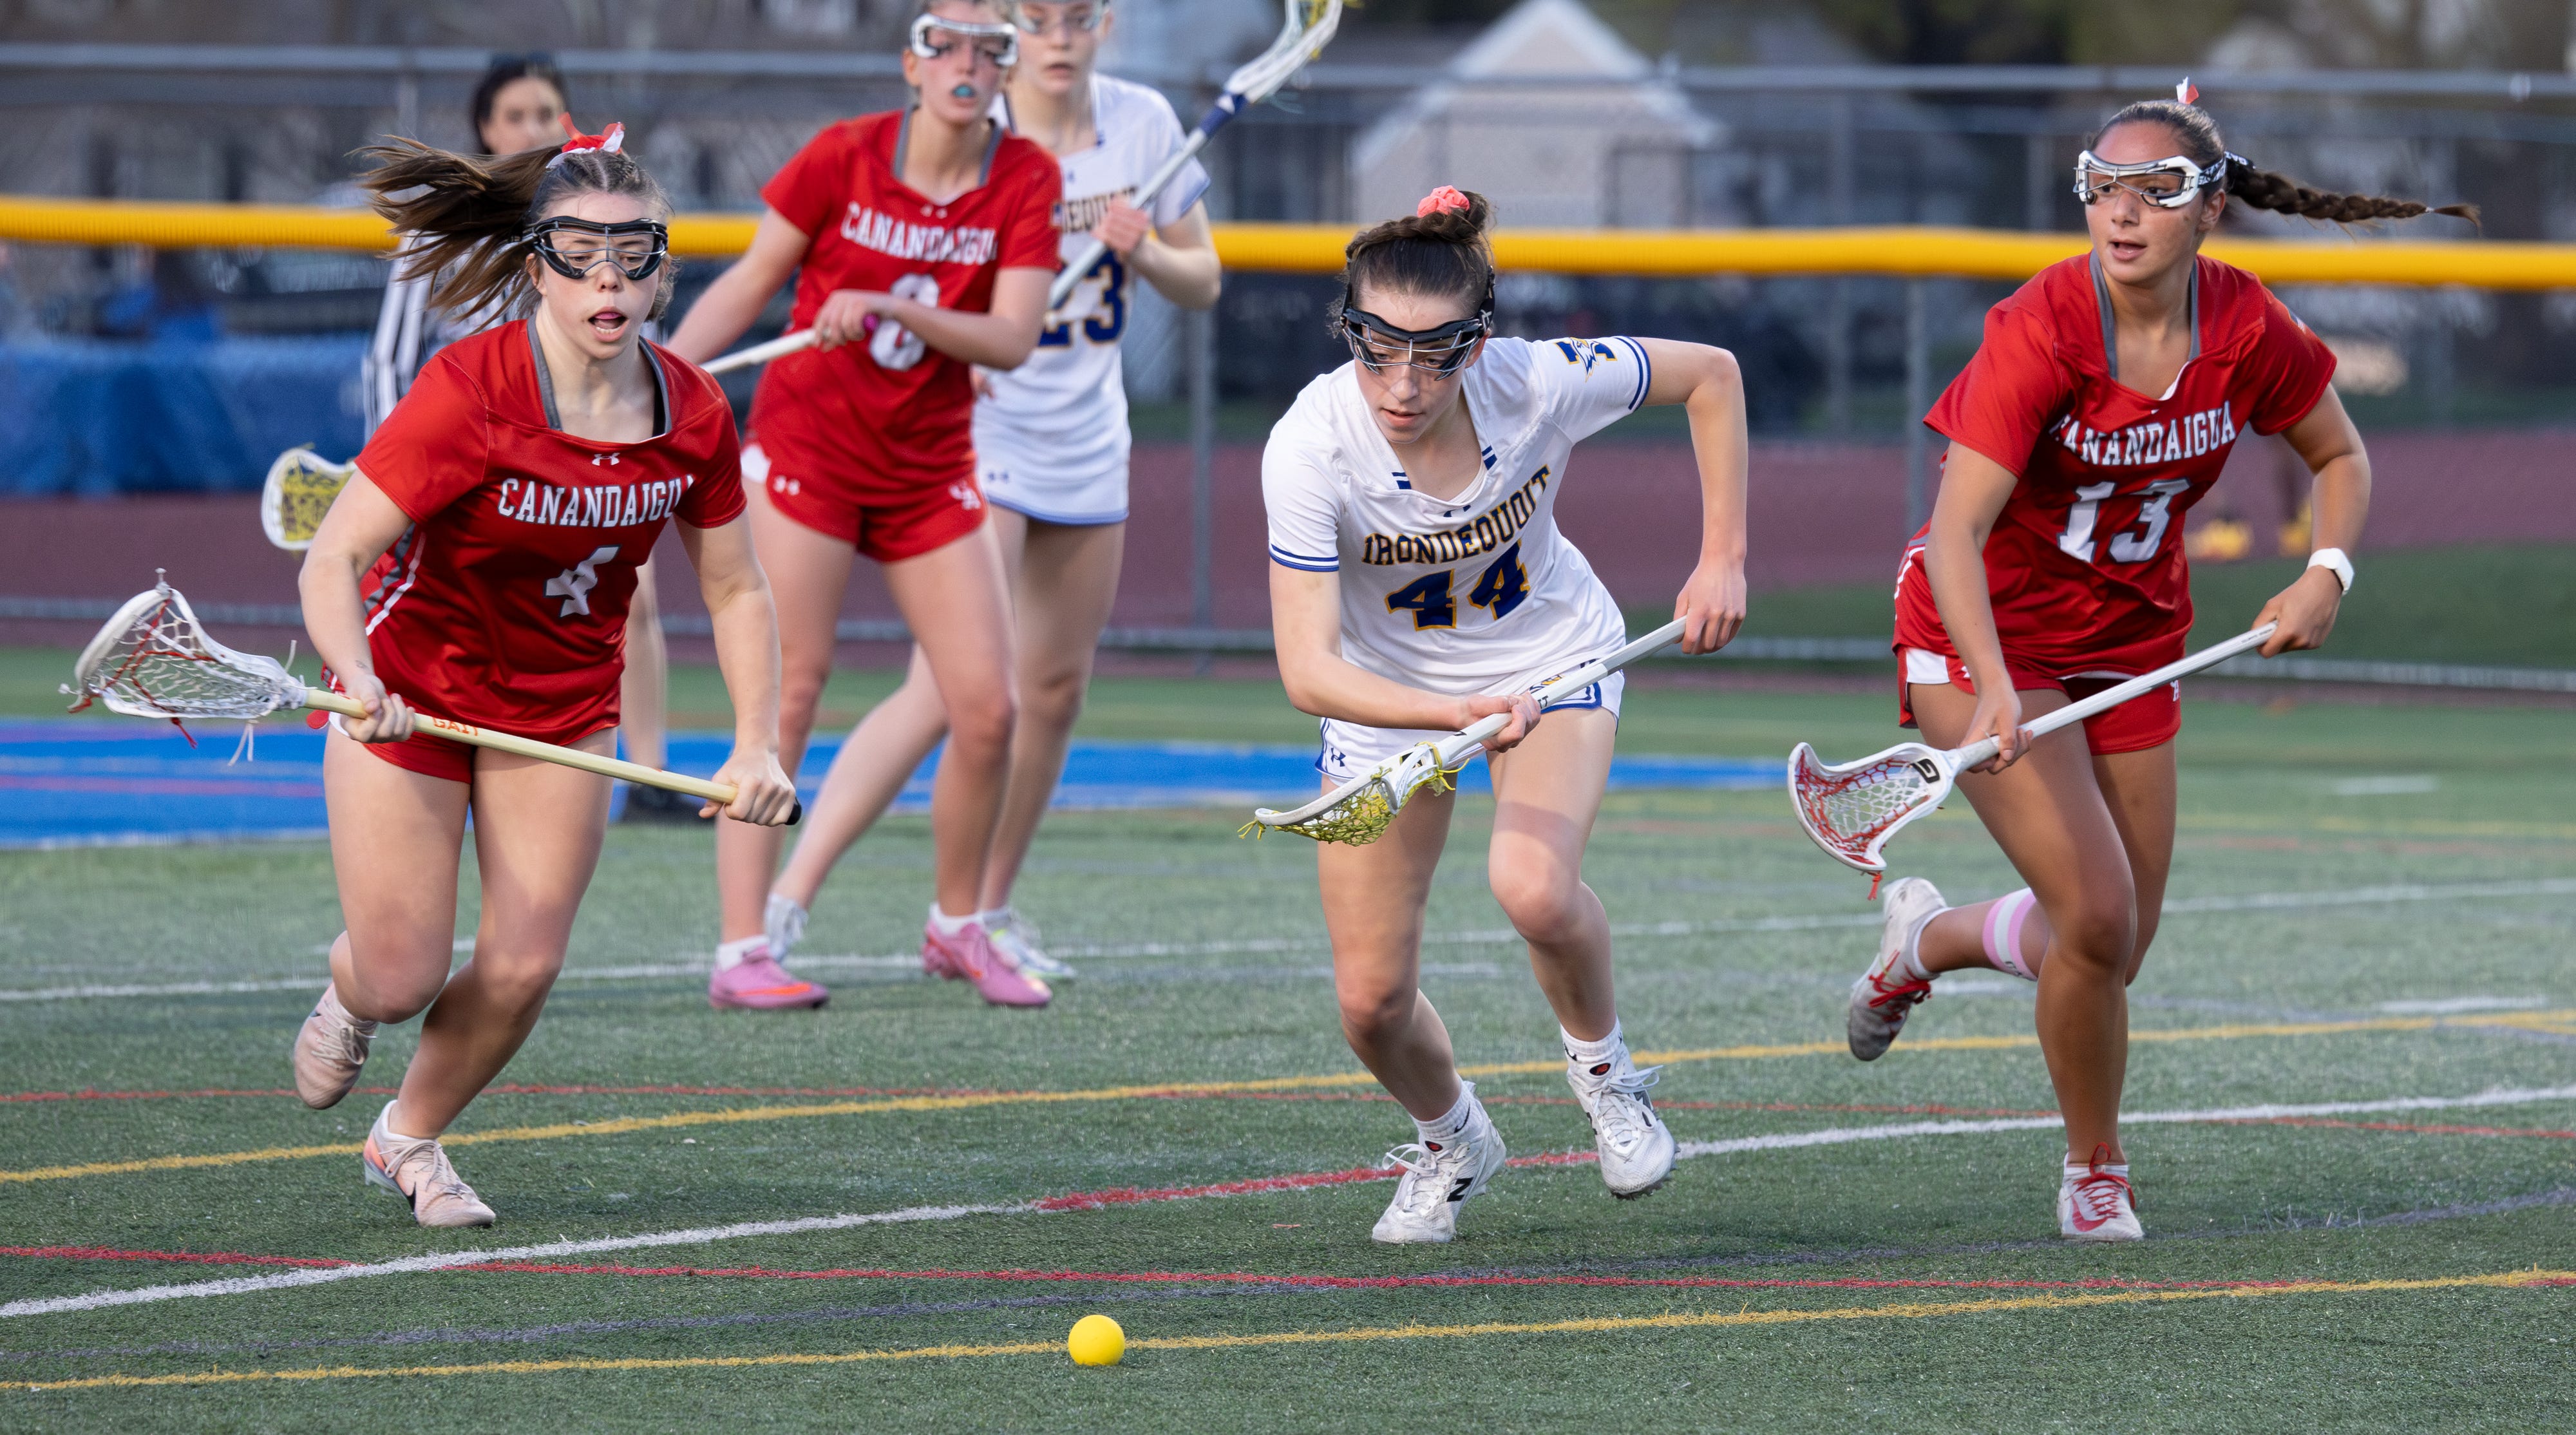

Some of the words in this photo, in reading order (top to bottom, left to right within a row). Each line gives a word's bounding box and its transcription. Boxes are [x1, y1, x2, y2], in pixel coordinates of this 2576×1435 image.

[840, 200, 998, 265] CANANDAIGU
[498, 474, 694, 527] CANANDAIGU
[1361, 464, 1551, 565] IRONDEQUOIT
[2056, 477, 2191, 564] 13
[544, 544, 622, 618] 4
[1384, 537, 1531, 631] 44
